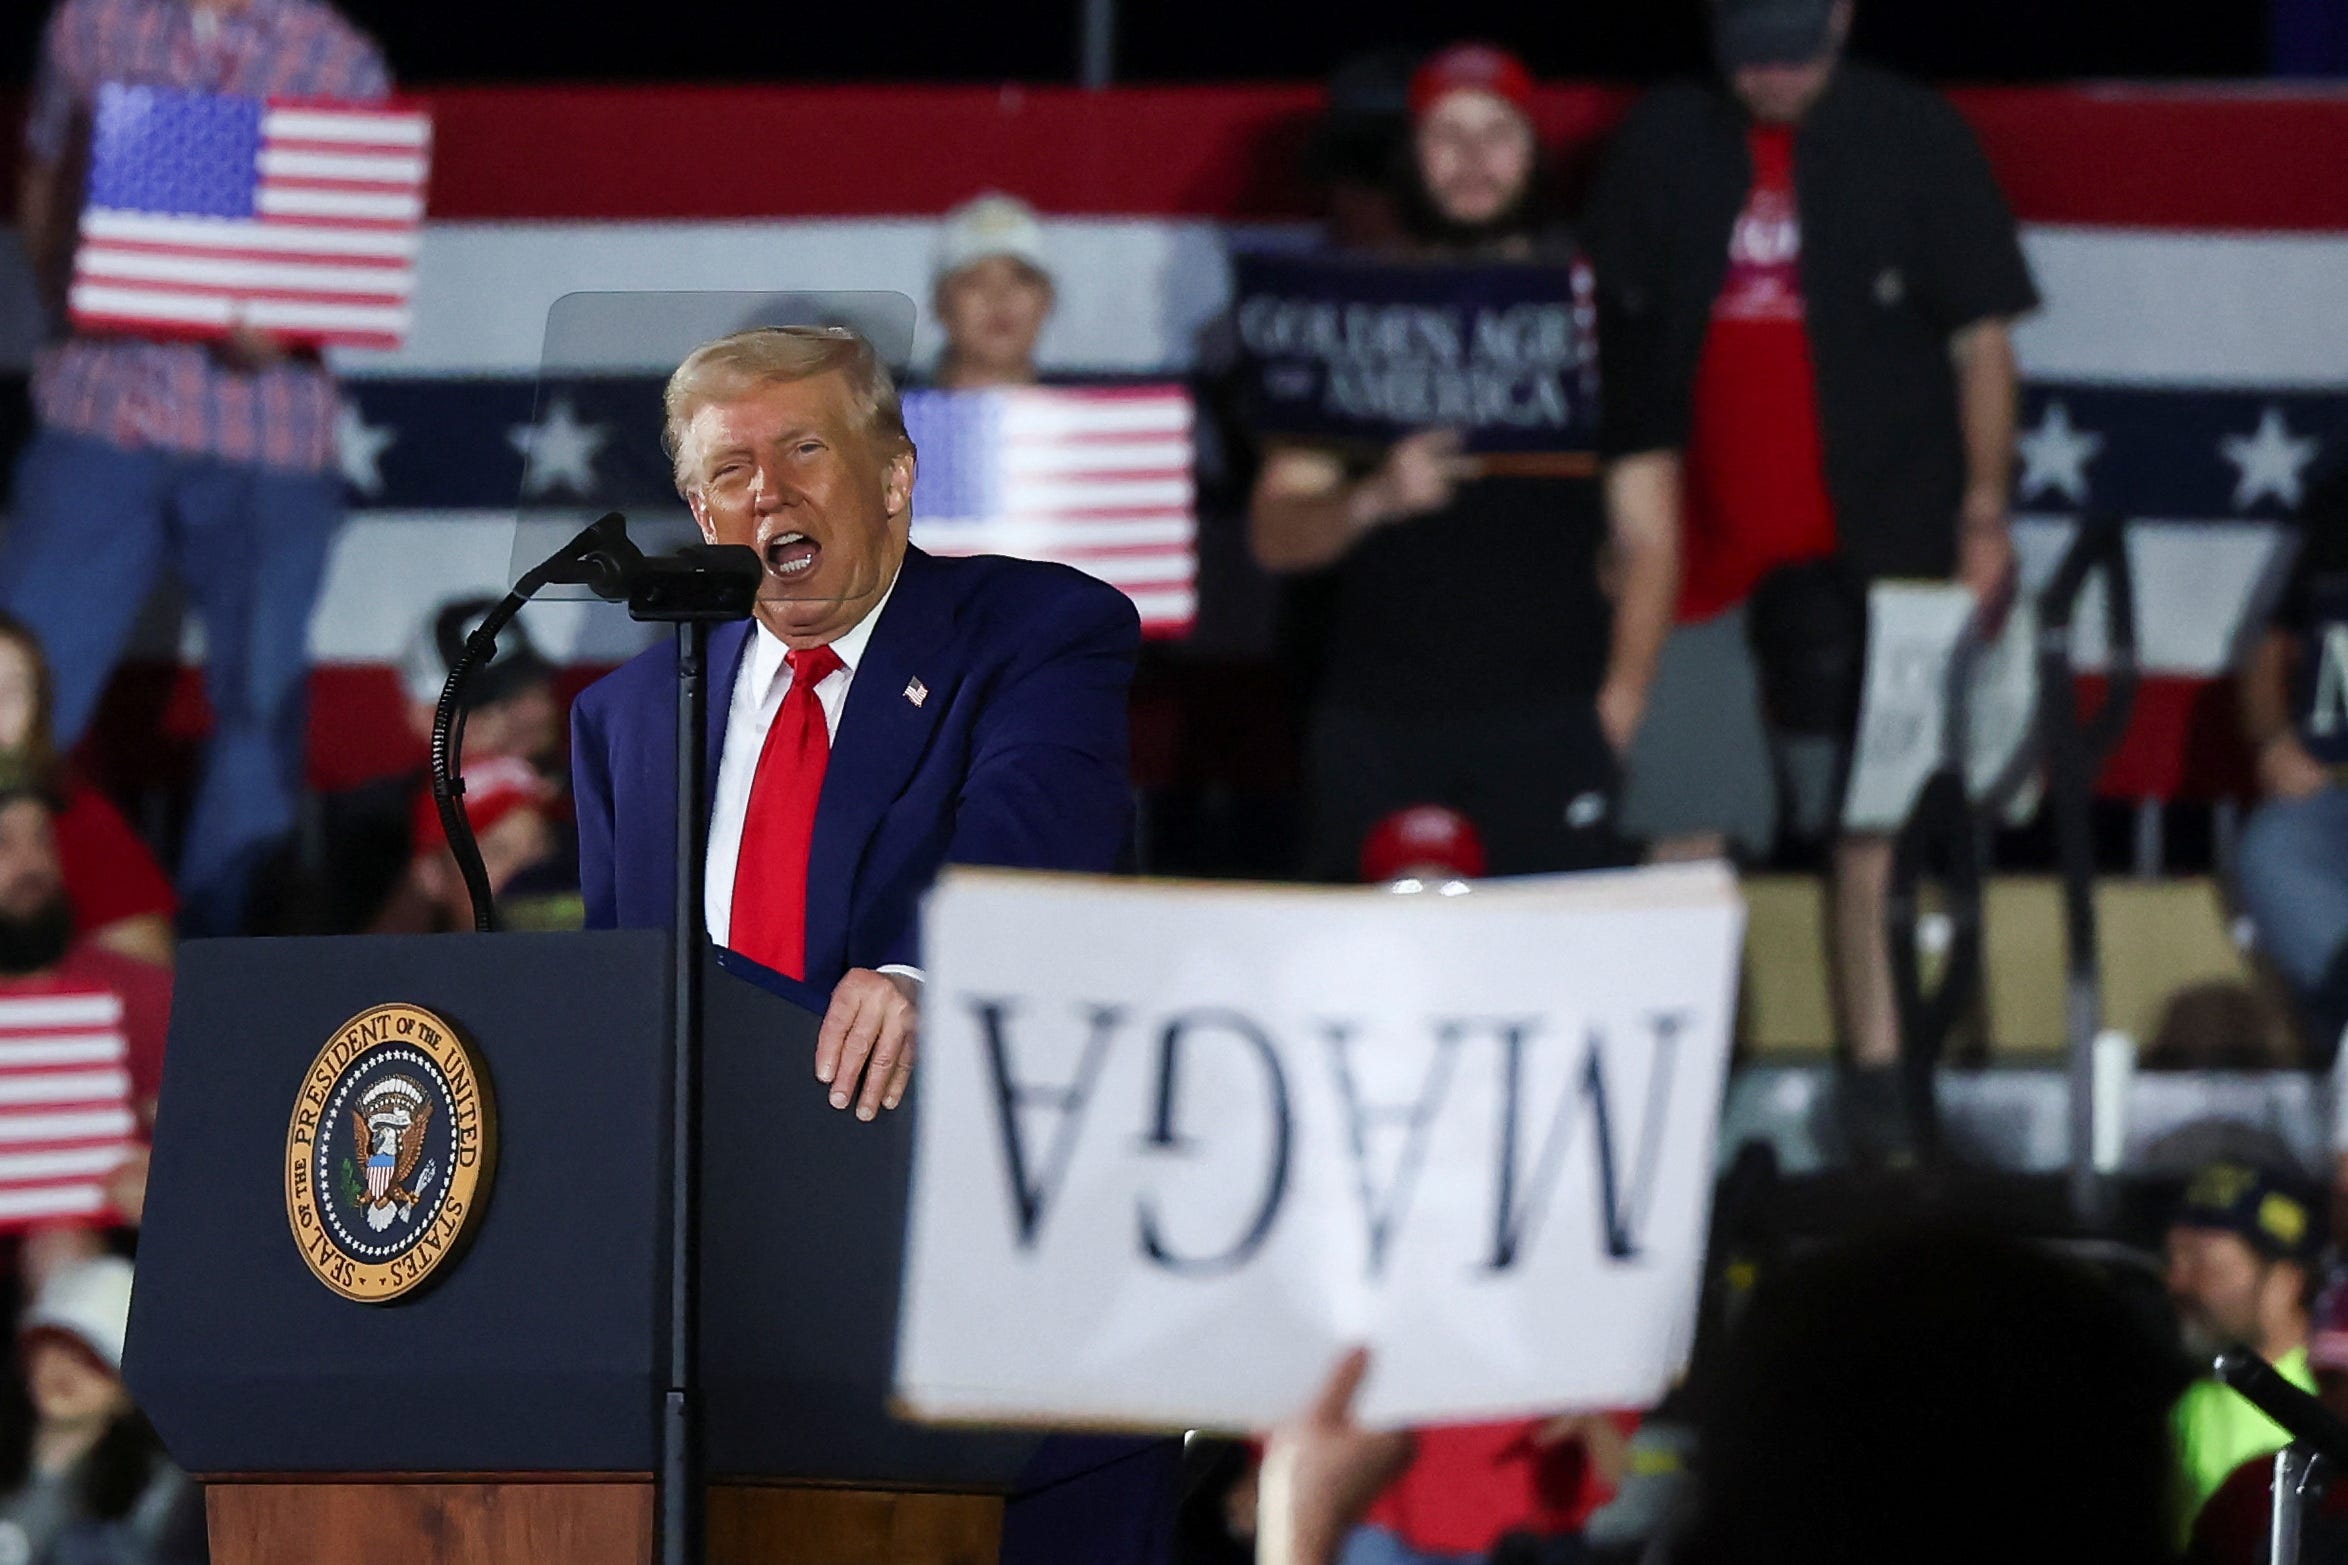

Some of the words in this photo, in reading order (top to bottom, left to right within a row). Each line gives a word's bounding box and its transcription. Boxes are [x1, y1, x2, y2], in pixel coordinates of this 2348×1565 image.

[396, 1017, 416, 1035] OF
[418, 1022, 442, 1050] THE
[295, 1014, 391, 1146] PRESIDENT
[443, 1047, 477, 1169] UNITED
[962, 992, 1702, 1278] MAGA
[293, 1157, 307, 1200] THE
[297, 1203, 312, 1229] OF
[390, 1195, 463, 1287] STATES
[308, 1226, 356, 1287] SEAL
